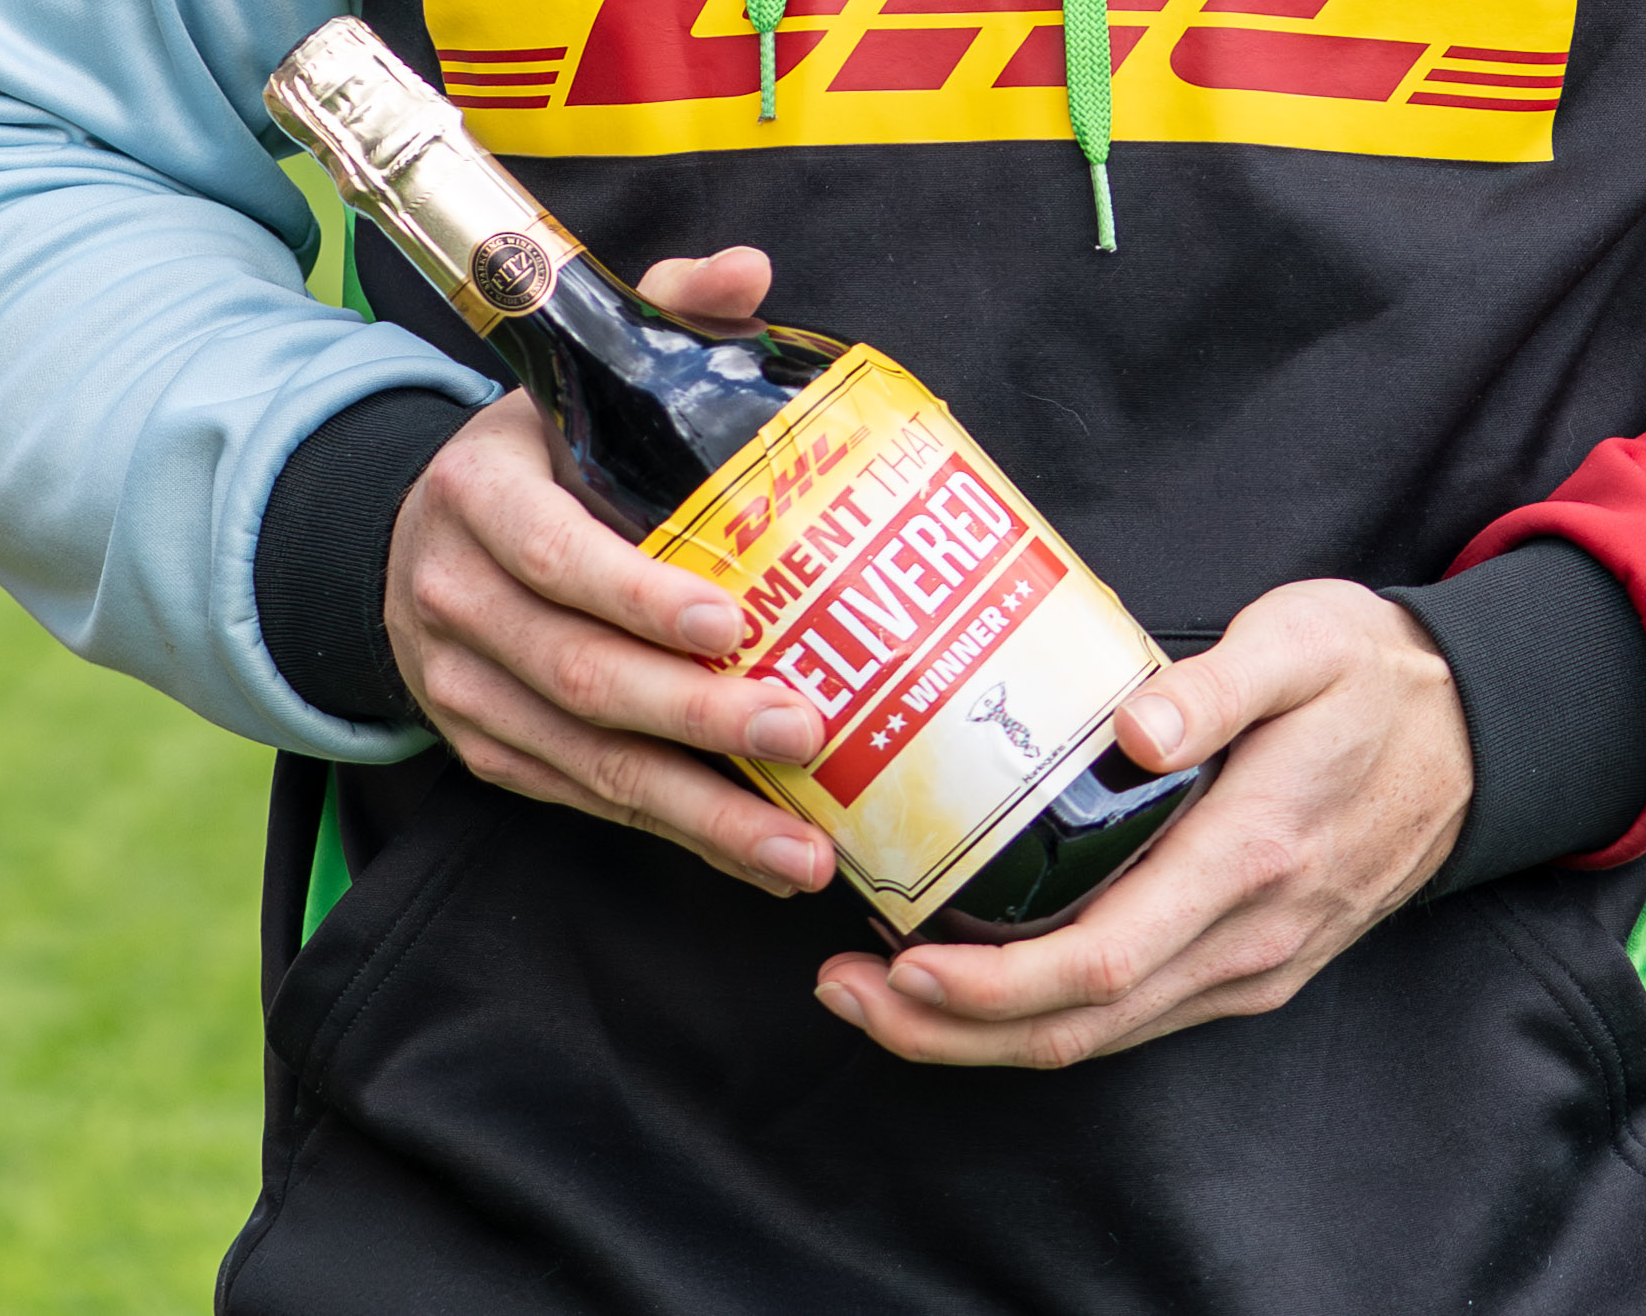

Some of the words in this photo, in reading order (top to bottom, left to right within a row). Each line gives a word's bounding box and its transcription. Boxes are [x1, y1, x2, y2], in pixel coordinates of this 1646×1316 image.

[491, 251, 533, 290] FITZ
[723, 432, 850, 558] DHL
[856, 411, 944, 498] THAT
[760, 470, 1013, 720] ELIVERED
[900, 604, 1011, 717] WINNER
